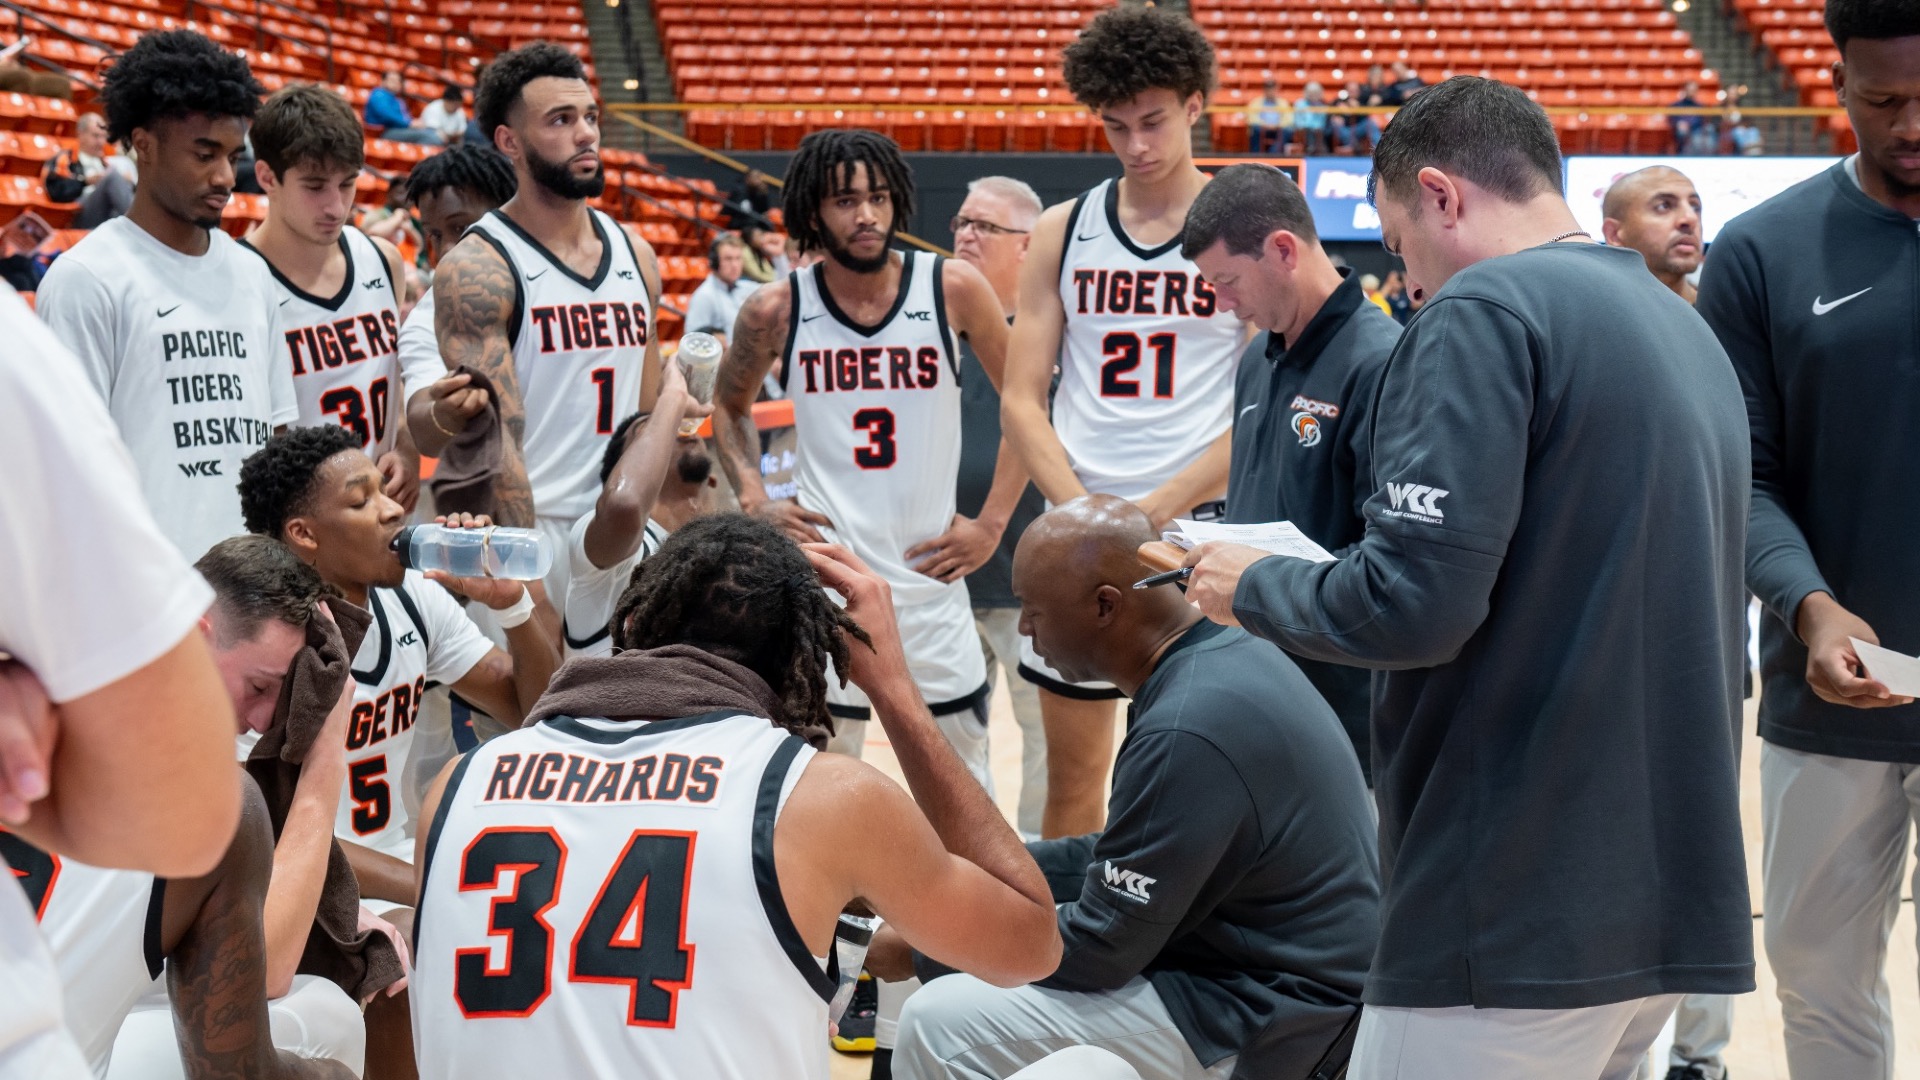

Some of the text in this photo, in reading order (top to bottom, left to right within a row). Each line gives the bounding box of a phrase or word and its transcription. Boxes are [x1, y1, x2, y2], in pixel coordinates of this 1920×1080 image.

[362, 277, 385, 290] WCC
[1074, 269, 1217, 318] TIGERS
[531, 302, 647, 354] TIGERS
[904, 310, 932, 321] WCC
[162, 330, 247, 362] PACIFIC
[284, 309, 399, 376] TIGERS
[1100, 331, 1177, 399] 21
[167, 374, 243, 405] TIGERS
[799, 346, 939, 394] TIGERS
[320, 376, 389, 448] 30
[591, 367, 615, 435] 1
[1290, 394, 1340, 418] PACIFIC
[852, 407, 897, 471] 3
[178, 459, 223, 478] WCC
[1386, 482, 1450, 518] WCC
[344, 674, 426, 752] GERS
[348, 754, 392, 837] 5
[484, 752, 725, 803] RICHARDS
[1104, 860, 1158, 900] WCC
[453, 826, 699, 1030] 34
